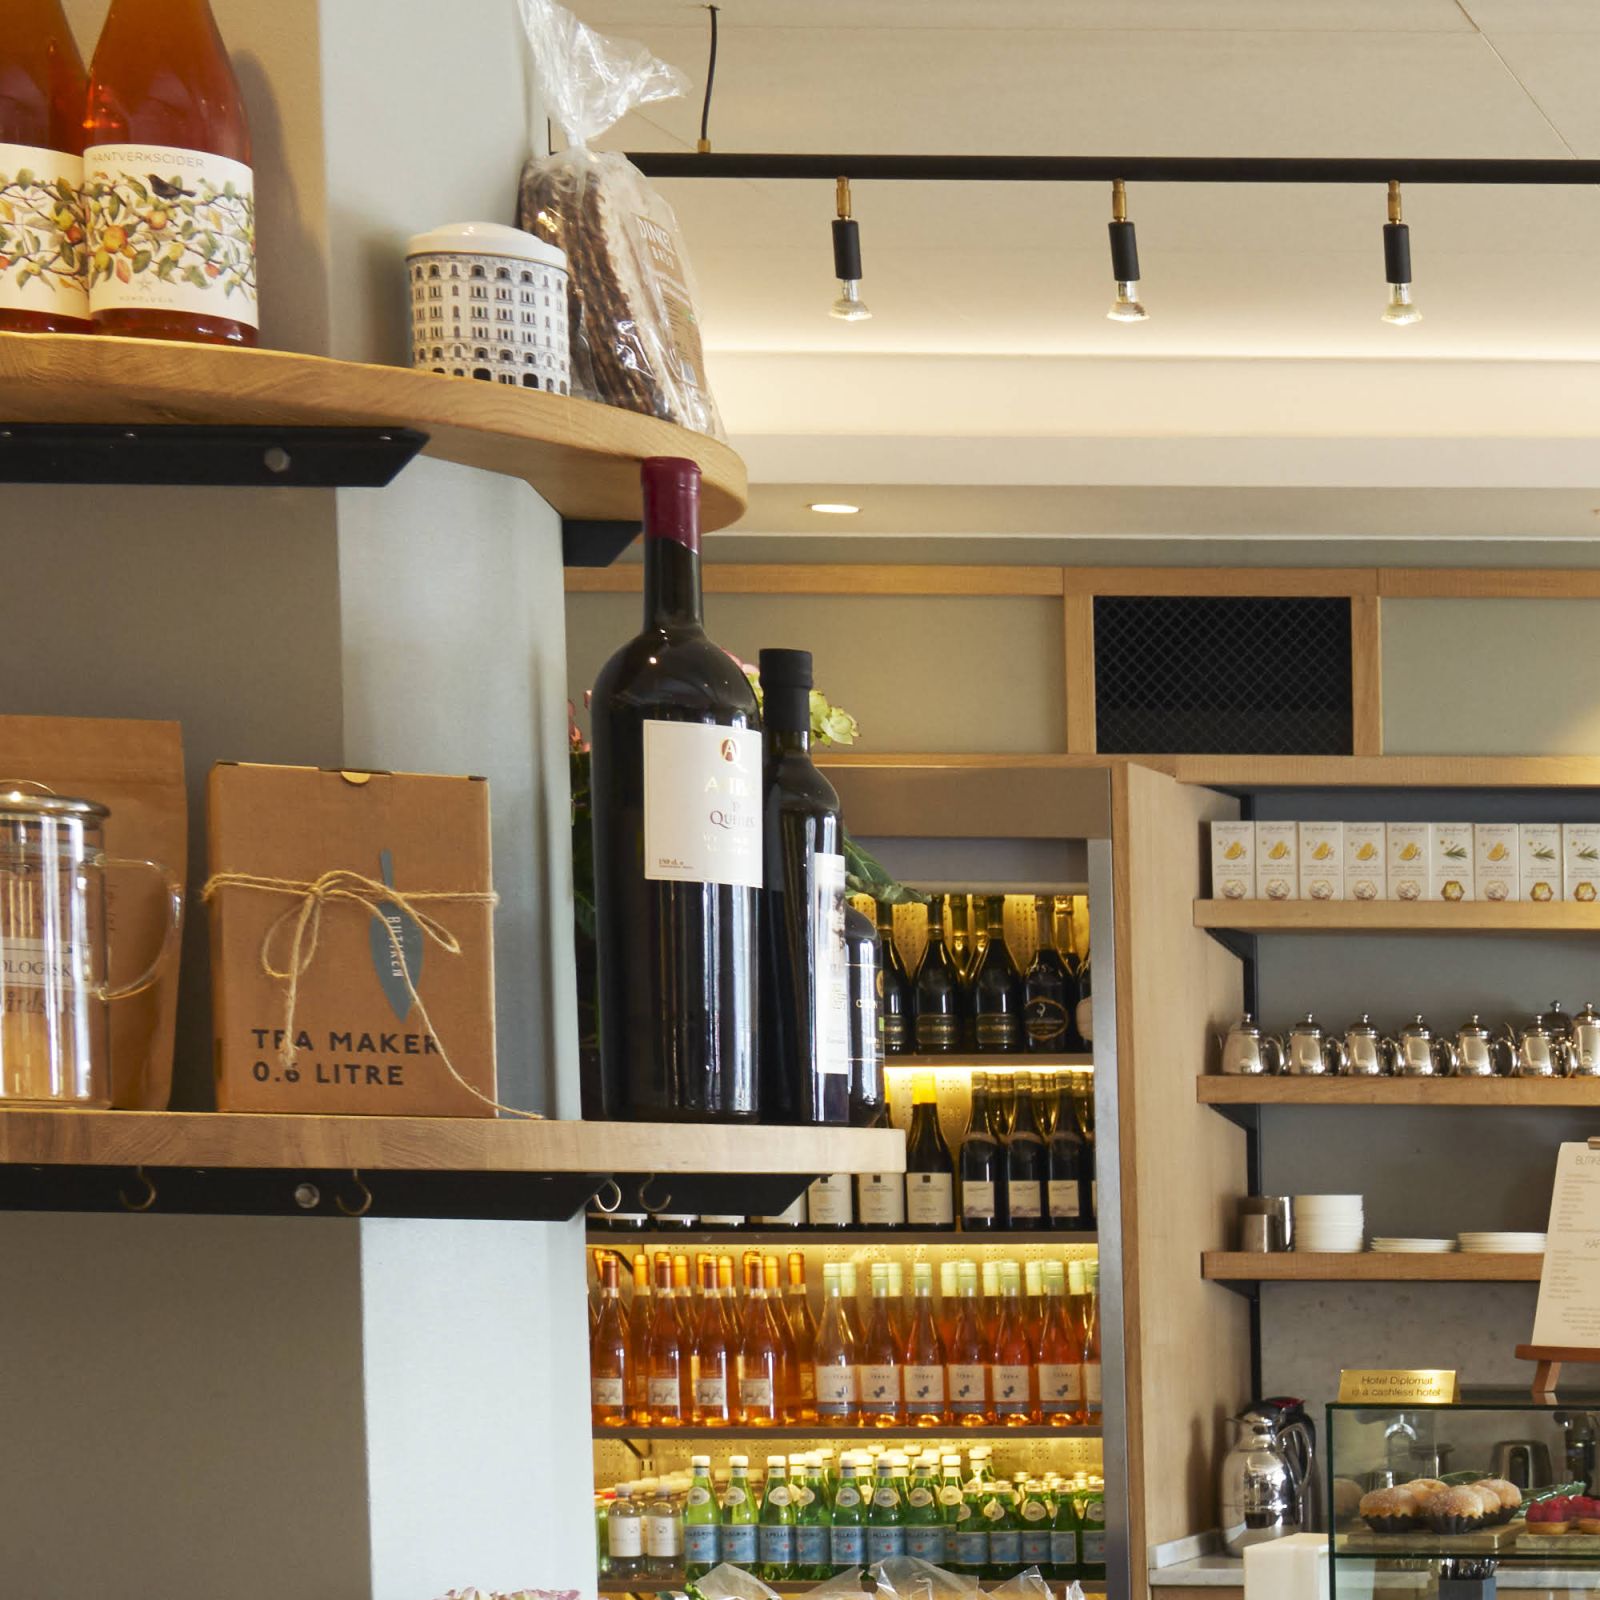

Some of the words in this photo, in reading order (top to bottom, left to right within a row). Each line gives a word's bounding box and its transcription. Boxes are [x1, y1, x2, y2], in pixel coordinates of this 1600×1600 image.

[386, 915, 406, 978] BUTIKEN
[252, 1028, 314, 1051] TEA
[329, 1031, 443, 1056] MAKER
[252, 1060, 301, 1084] 0.6
[315, 1063, 404, 1087] LITRE
[1361, 1375, 1388, 1385] Hotel
[1390, 1375, 1434, 1386] Diplomat
[1371, 1387, 1414, 1397] cashless
[1416, 1387, 1441, 1397] hotel
